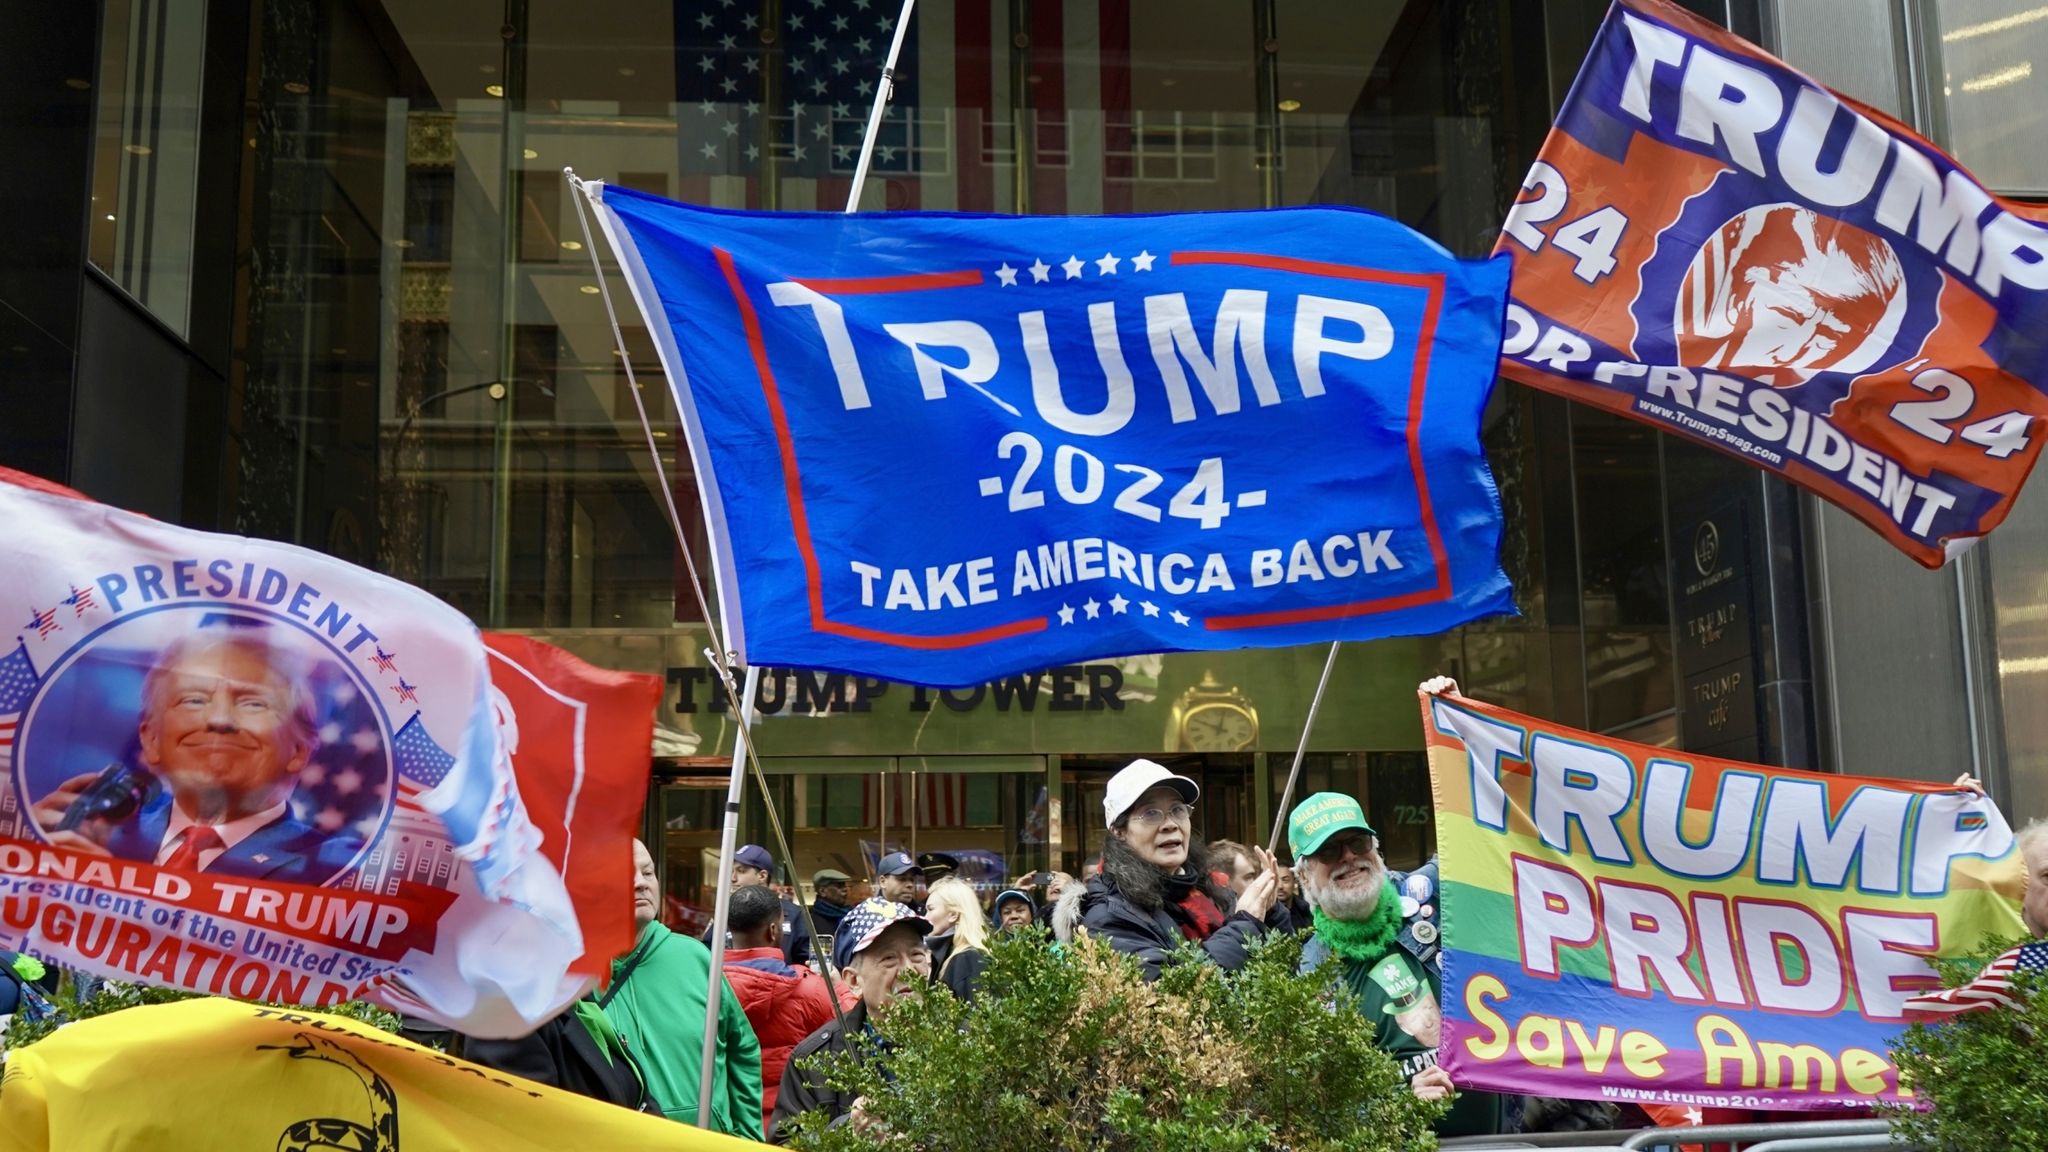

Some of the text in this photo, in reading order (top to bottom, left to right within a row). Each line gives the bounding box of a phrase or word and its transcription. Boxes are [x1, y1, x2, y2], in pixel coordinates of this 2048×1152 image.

[1620, 11, 2048, 298] TRUMP
[766, 282, 1395, 436] TRUMP
[1501, 304, 1958, 538] OR PRESIDENT
[1639, 399, 1782, 464] www.TrumpSwag.com
[96, 559, 378, 654] PRESIDENT
[850, 529, 1403, 612] TAKE AMERICA BACK
[1687, 603, 1737, 638] TRUMP
[666, 665, 889, 714] TRUMP
[1692, 672, 1741, 702] TRUMP
[1304, 813, 1329, 836] GREAT
[1393, 804, 1430, 825] 725
[1432, 698, 2018, 898] TRUMP
[0, 843, 409, 949] ONALD TRUMP
[1511, 852, 1939, 1022] PRIDE
[3, 895, 310, 1005] UGURATION
[152, 907, 185, 931] of
[188, 913, 236, 948] the
[242, 928, 340, 976] United
[1384, 975, 1417, 995] MAKE
[1464, 973, 1669, 1080] Save
